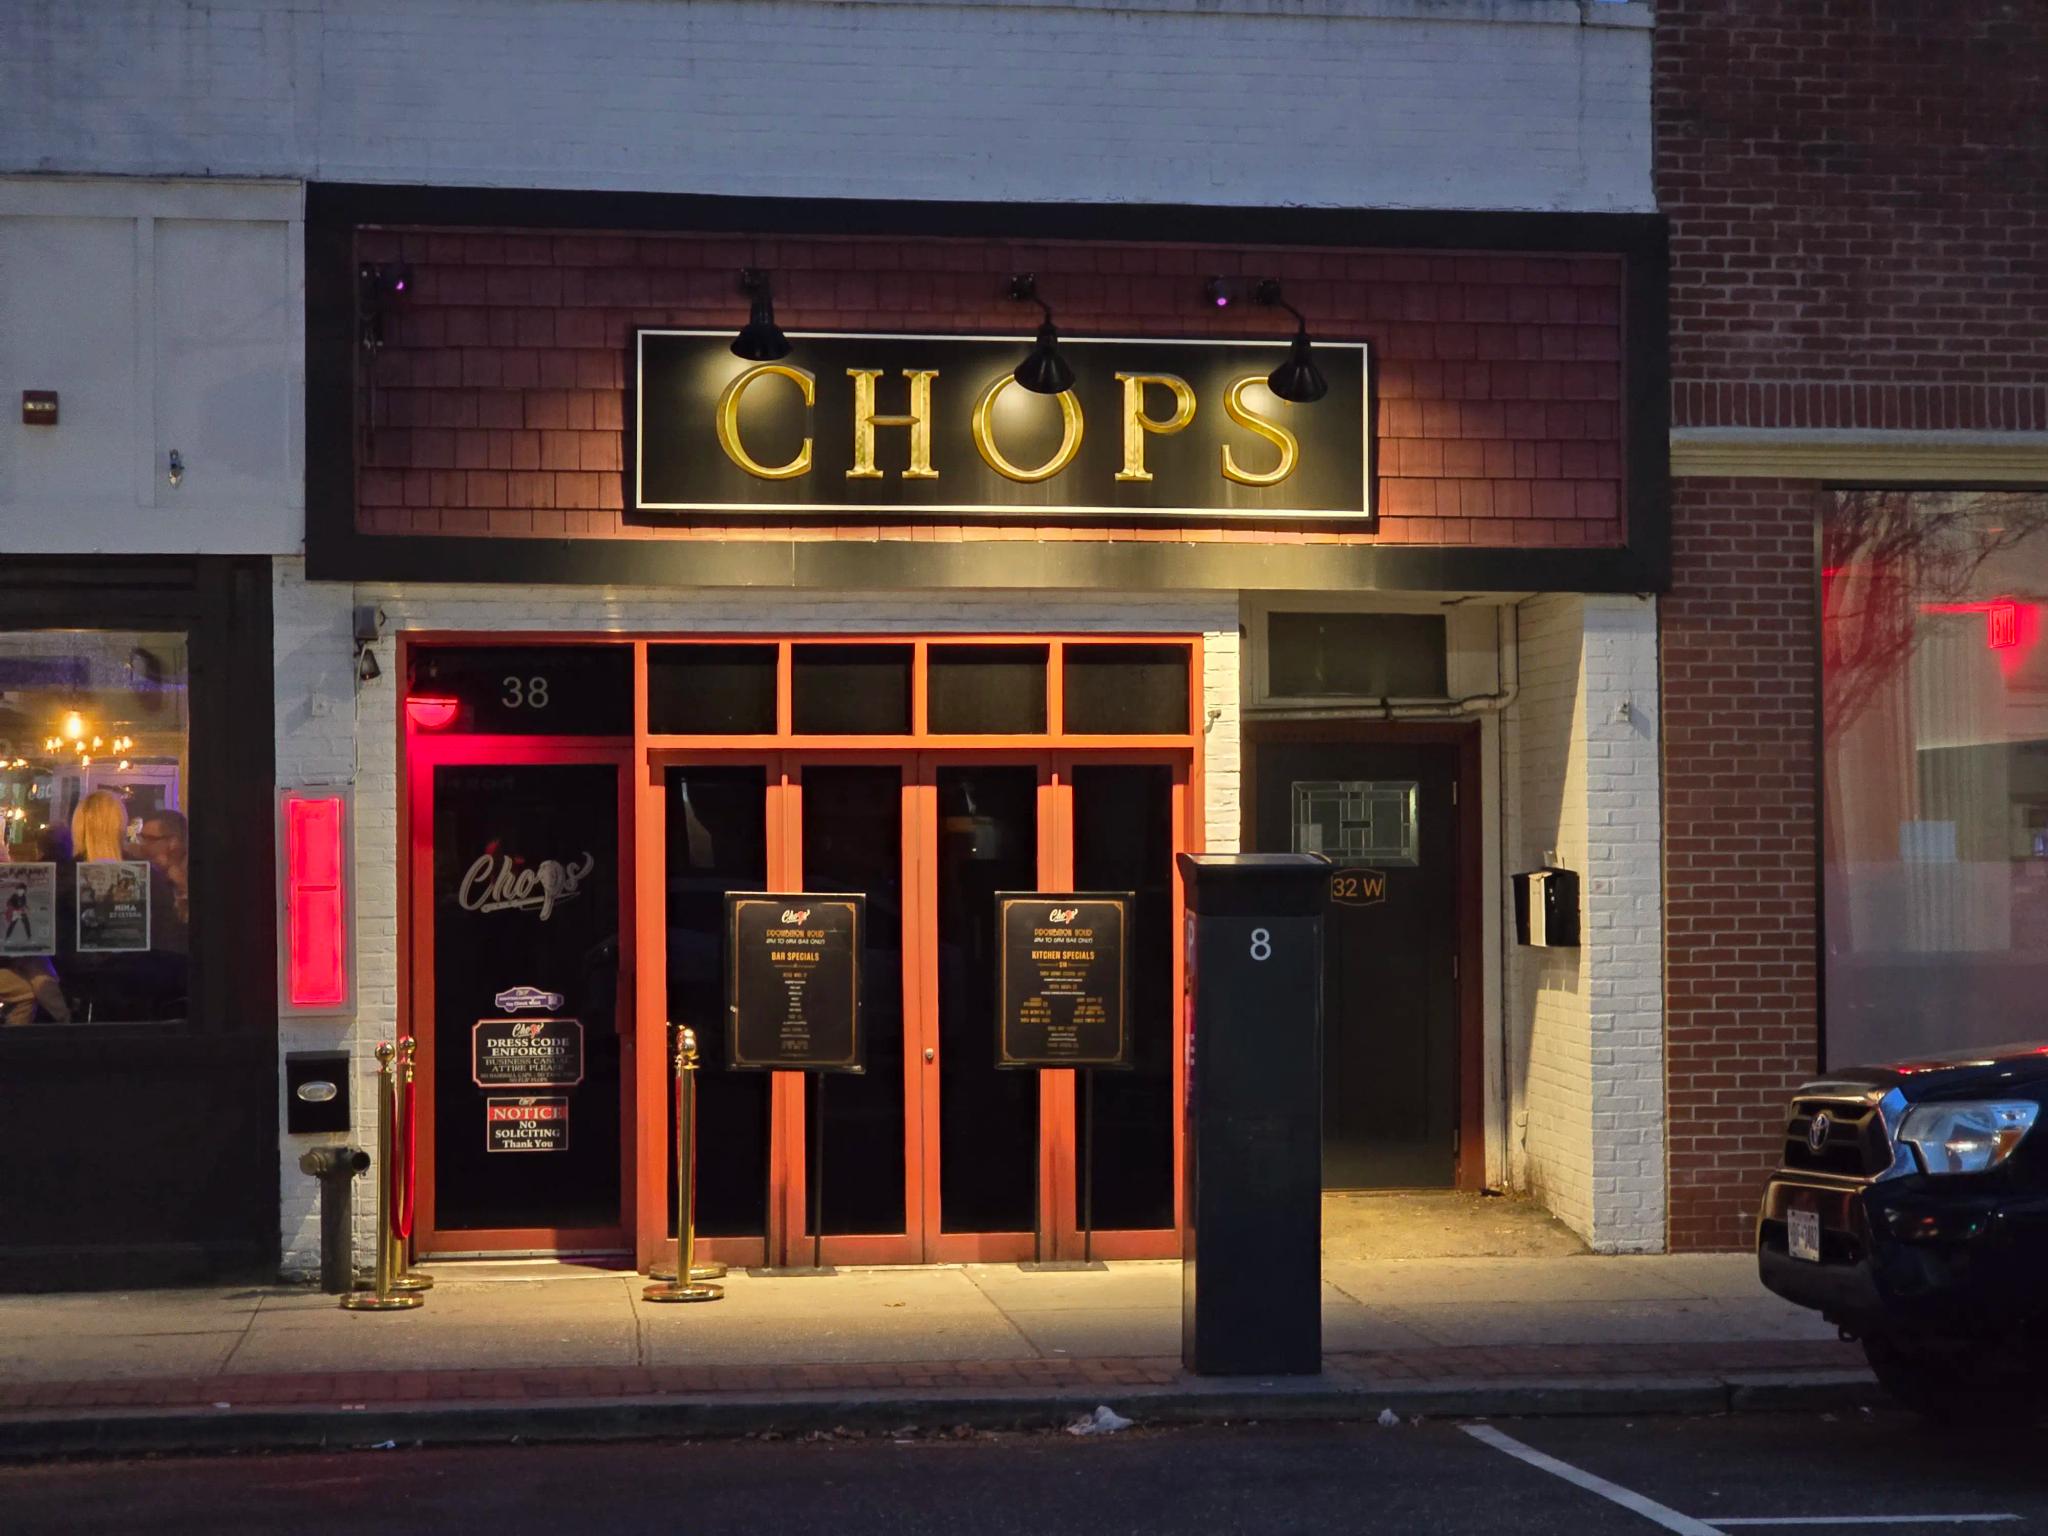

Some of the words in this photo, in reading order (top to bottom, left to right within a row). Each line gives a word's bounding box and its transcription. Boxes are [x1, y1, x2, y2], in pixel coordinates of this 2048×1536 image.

[715, 362, 1299, 487] CHOPS
[502, 676, 549, 708] 38
[459, 851, 595, 921] Chops
[1333, 878, 1357, 897] 32
[1363, 878, 1383, 897] W
[1250, 928, 1272, 961] 8
[771, 951, 786, 961] BAR
[787, 951, 820, 961] SPECIALS
[1031, 950, 1061, 960] KITCHEN
[1062, 950, 1095, 960] SPECIALS
[487, 1038, 529, 1048] DRESS
[531, 1038, 569, 1047] CODE
[492, 1047, 565, 1056] ENFORCED
[494, 1107, 562, 1120] NOTICE
[519, 1120, 537, 1129] NO
[495, 1129, 560, 1138] SOLICITING
[502, 1140, 533, 1148] Thank
[534, 1140, 553, 1148] You
